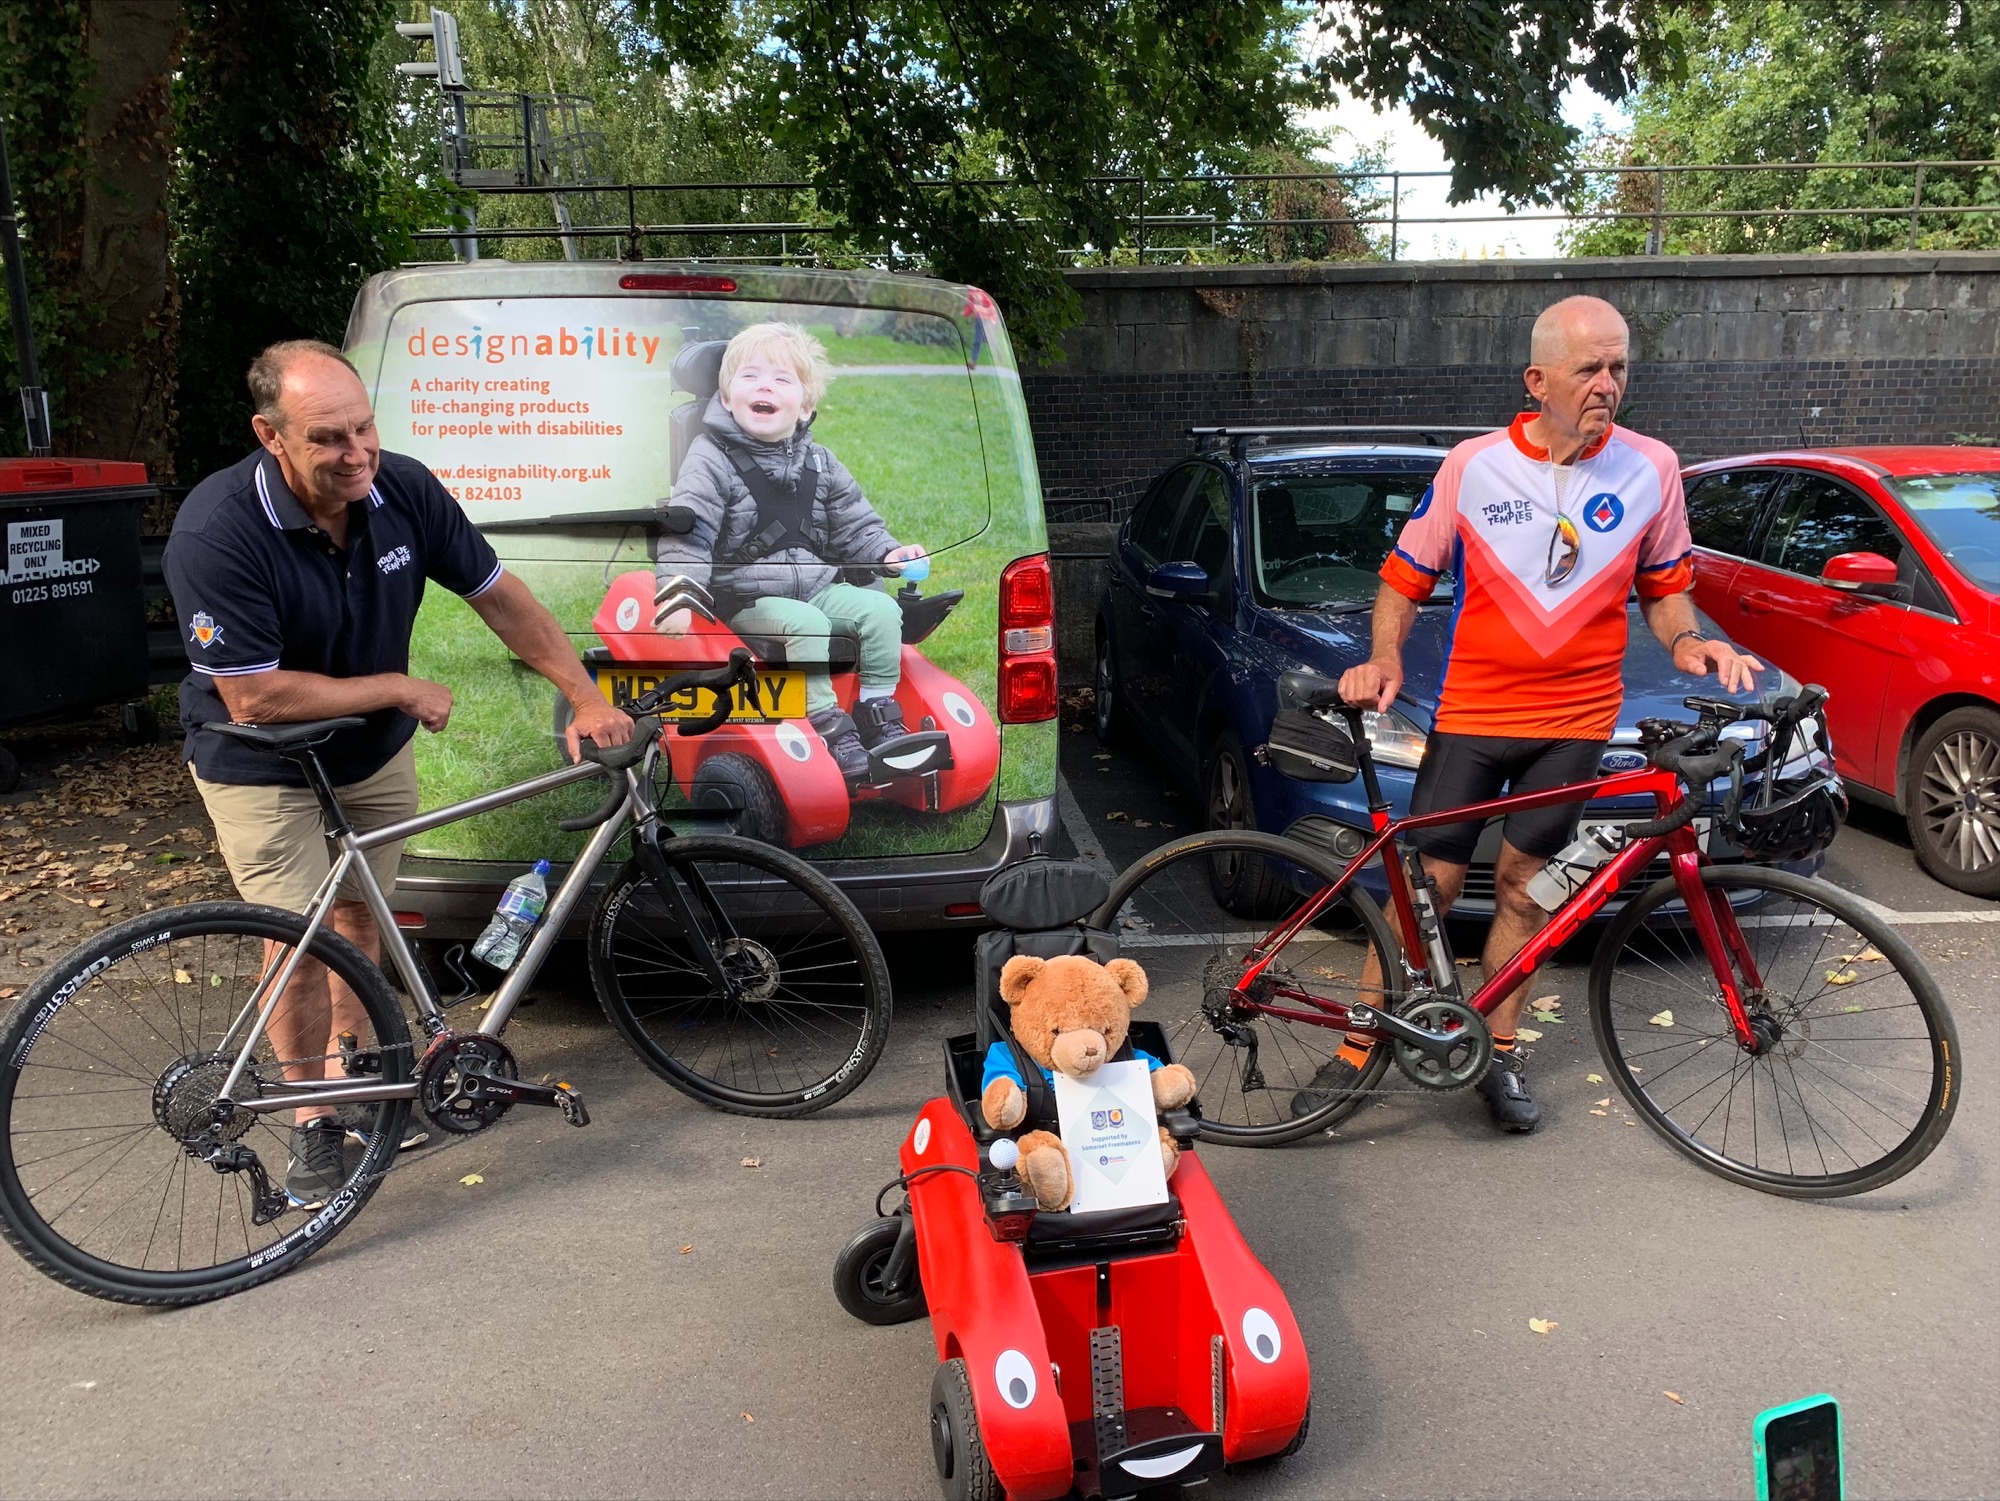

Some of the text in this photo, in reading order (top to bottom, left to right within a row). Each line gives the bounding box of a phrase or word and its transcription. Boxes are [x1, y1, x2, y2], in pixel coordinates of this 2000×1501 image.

[407, 326, 660, 364] designability
[410, 378, 551, 395] A charity creating
[411, 399, 589, 417] life-changing products
[412, 420, 623, 439] for people with disabilities
[465, 486, 522, 501] 824103
[1482, 500, 1533, 515] TOUR DE
[1488, 511, 1532, 526] TEMPLES
[20, 524, 51, 538] MIXED
[10, 539, 61, 555] RECYCLING
[24, 555, 47, 569] ONLY
[377, 545, 410, 568] TOUR DE
[12, 579, 93, 604] 01225 891591
[1609, 755, 1636, 768] Ford
[131, 935, 155, 951] SWISS
[1091, 1133, 1120, 1143] Supported
[1108, 1140, 1141, 1148] Freemasons
[251, 1246, 288, 1268] DT SWISS
